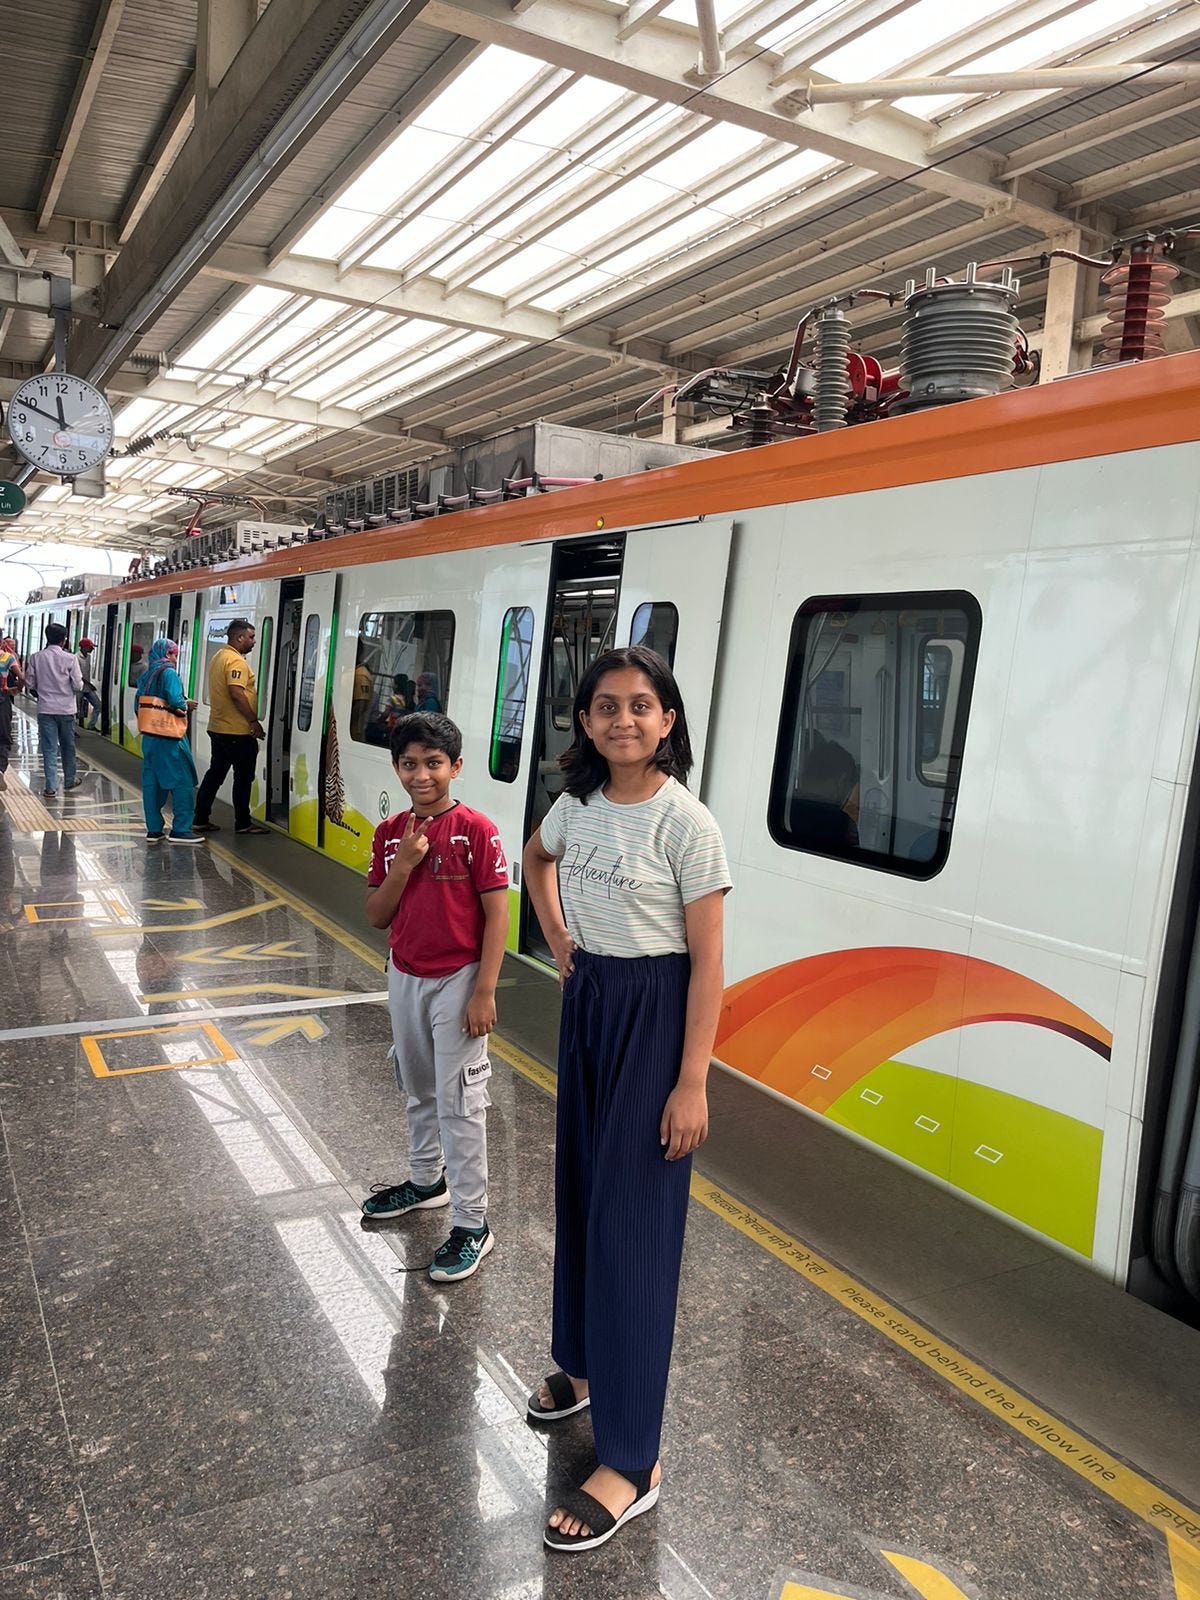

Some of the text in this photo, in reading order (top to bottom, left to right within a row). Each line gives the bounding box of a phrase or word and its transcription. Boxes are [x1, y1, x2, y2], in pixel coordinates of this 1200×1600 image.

[39, 386, 48, 397] 11
[56, 383, 68, 394] 12
[79, 391, 83, 401] 1
[24, 396, 37, 408] 10
[18, 413, 27, 424] 9
[97, 423, 105, 434] 3
[25, 431, 34, 443] 8
[40, 445, 49, 456] 7
[78, 450, 87, 461] 5
[59, 453, 67, 464] 6
[231, 669, 242, 679] 07
[561, 843, 643, 900] Adventure
[768, 1235, 793, 1250] मागे
[785, 1248, 810, 1263] उभे
[805, 1261, 829, 1276] रहा
[841, 1287, 1117, 1482] Please stand behind the yellow line
